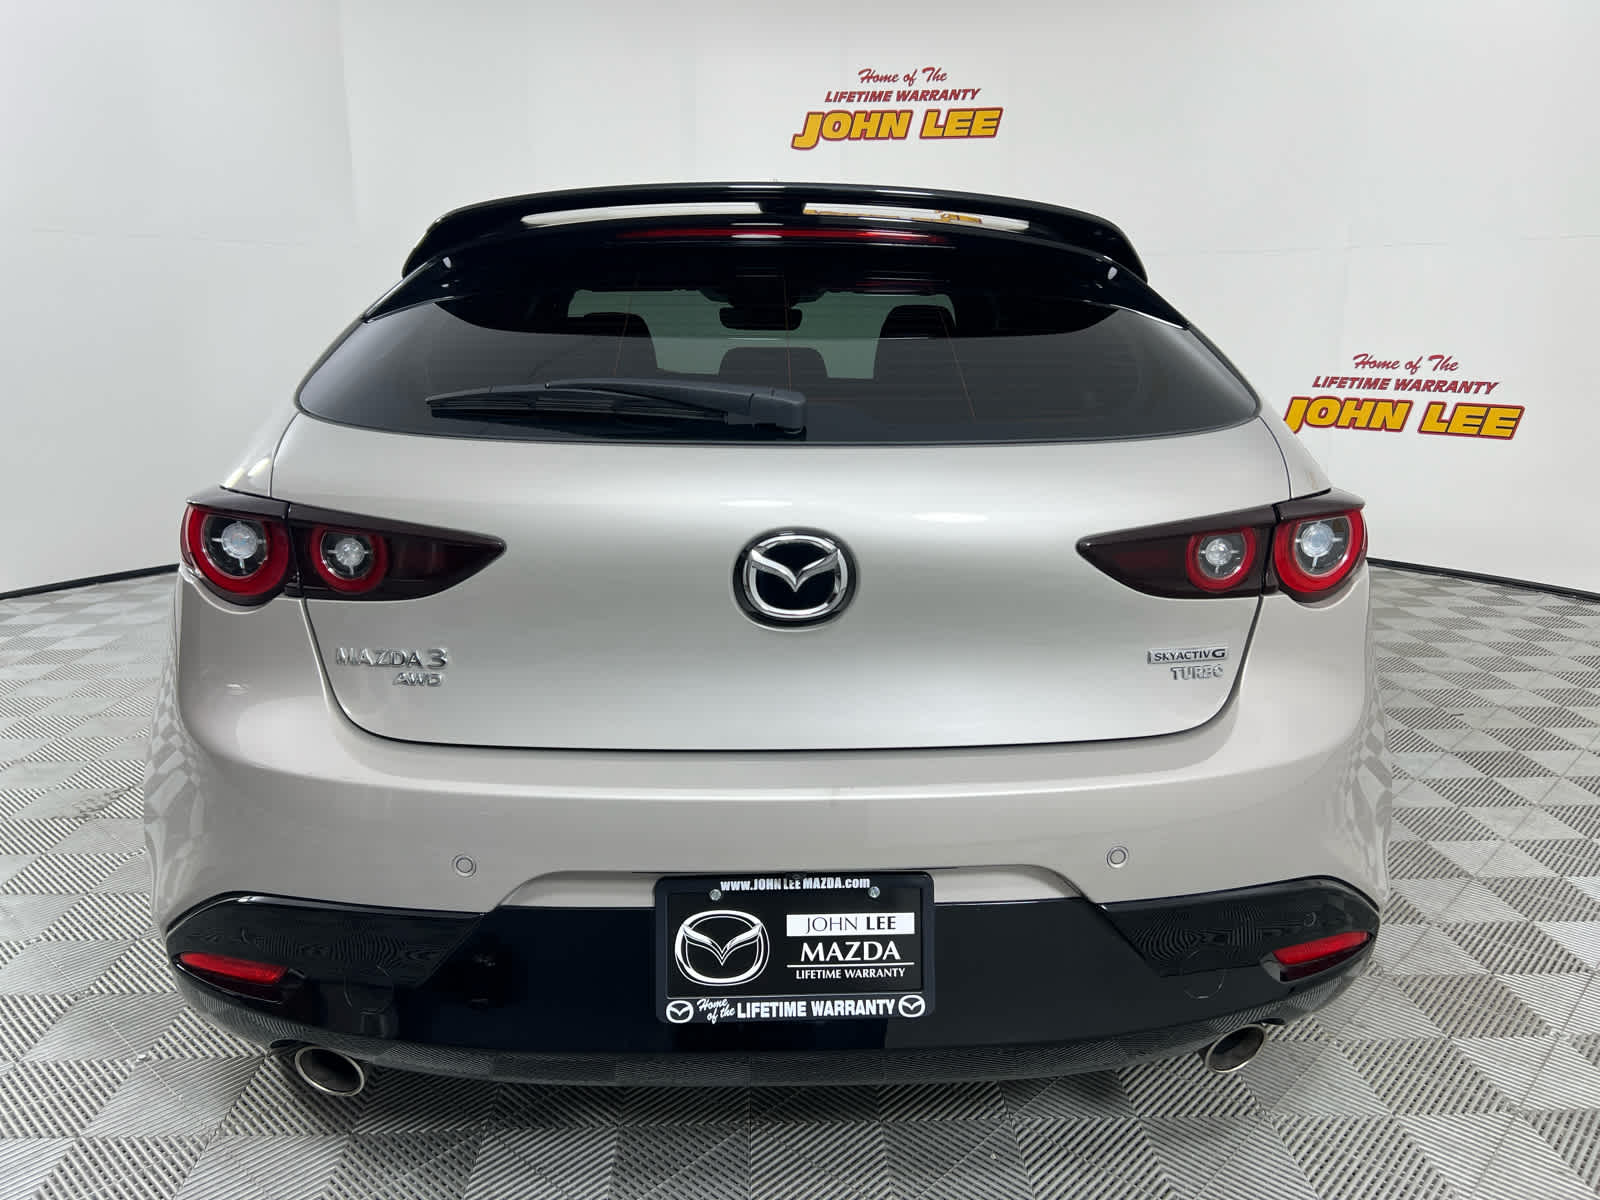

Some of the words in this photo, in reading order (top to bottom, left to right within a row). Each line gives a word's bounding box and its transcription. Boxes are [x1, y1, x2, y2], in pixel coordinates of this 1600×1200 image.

[857, 68, 900, 84] Home
[903, 69, 918, 87] of
[922, 67, 947, 83] The
[824, 90, 893, 103] LIFETIME
[896, 88, 982, 102] WARRANTY
[791, 109, 914, 150] JOHN
[919, 107, 1004, 139] LEE
[1353, 353, 1400, 371] Home
[1404, 356, 1423, 375] of
[1428, 355, 1459, 372] The
[1311, 375, 1391, 391] LIFETIME
[1394, 379, 1499, 395] WARRANTY
[1283, 395, 1414, 434] JOHN
[1417, 401, 1526, 440] LEE
[336, 647, 424, 668] MAZDA
[427, 647, 448, 669] 3
[392, 671, 444, 687] AWD
[1170, 664, 1223, 680] TURBO
[807, 916, 858, 934] JOHN
[866, 916, 897, 931] LEE
[801, 941, 901, 961] MAZDA
[796, 970, 842, 980] LIFETIME
[845, 968, 906, 979] WARRANTY
[697, 998, 728, 1012] Home
[737, 1001, 807, 1019] LIFETIME
[811, 999, 896, 1017] WARRANTY
[707, 1011, 718, 1025] of
[720, 1006, 736, 1018] the
